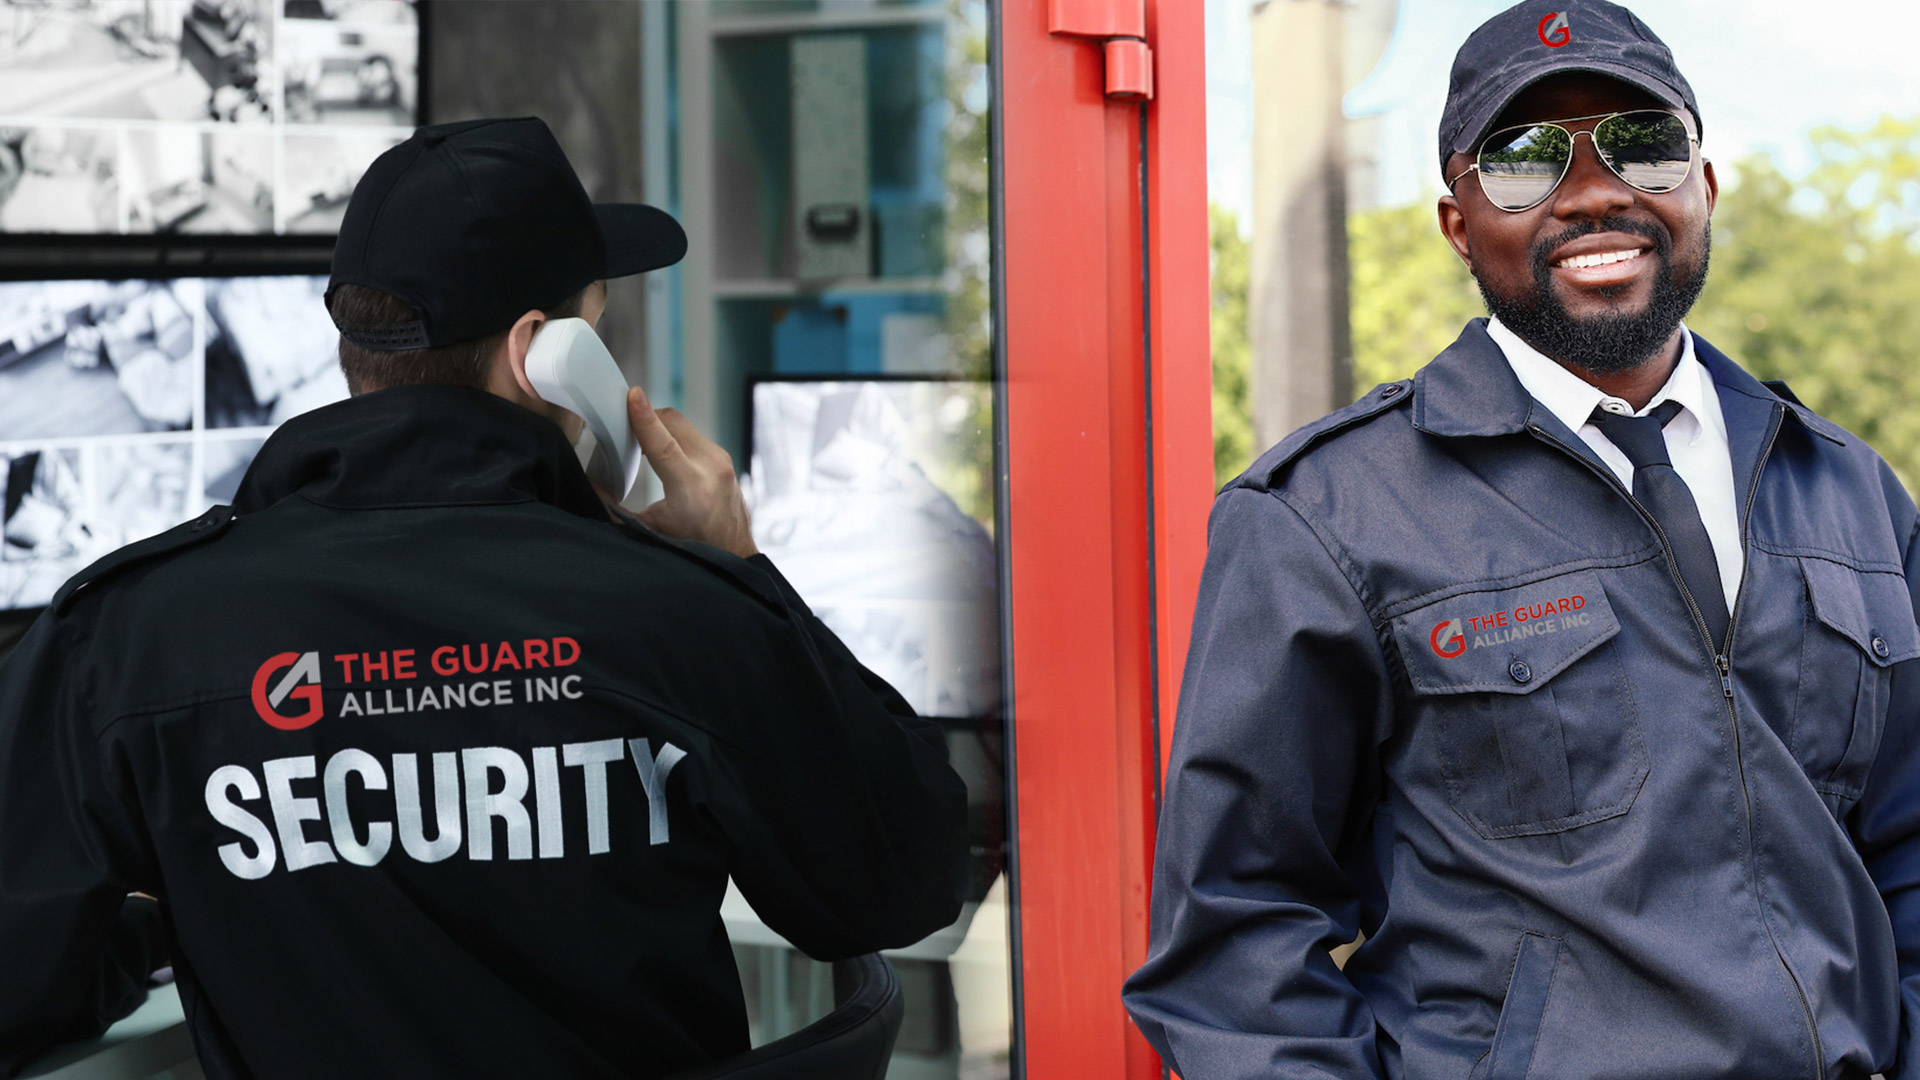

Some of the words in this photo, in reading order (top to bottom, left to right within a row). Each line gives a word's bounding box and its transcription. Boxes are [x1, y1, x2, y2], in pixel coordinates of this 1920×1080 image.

[1467, 611, 1509, 632] THE
[1514, 595, 1586, 622] GUARD
[1473, 619, 1556, 650] ALLIANCE
[1561, 612, 1590, 631] INC
[334, 649, 417, 684] THE
[431, 636, 581, 676] GUARD
[339, 681, 513, 717] ALLIANCE
[525, 675, 584, 702] INC
[204, 737, 688, 880] SECURITY
